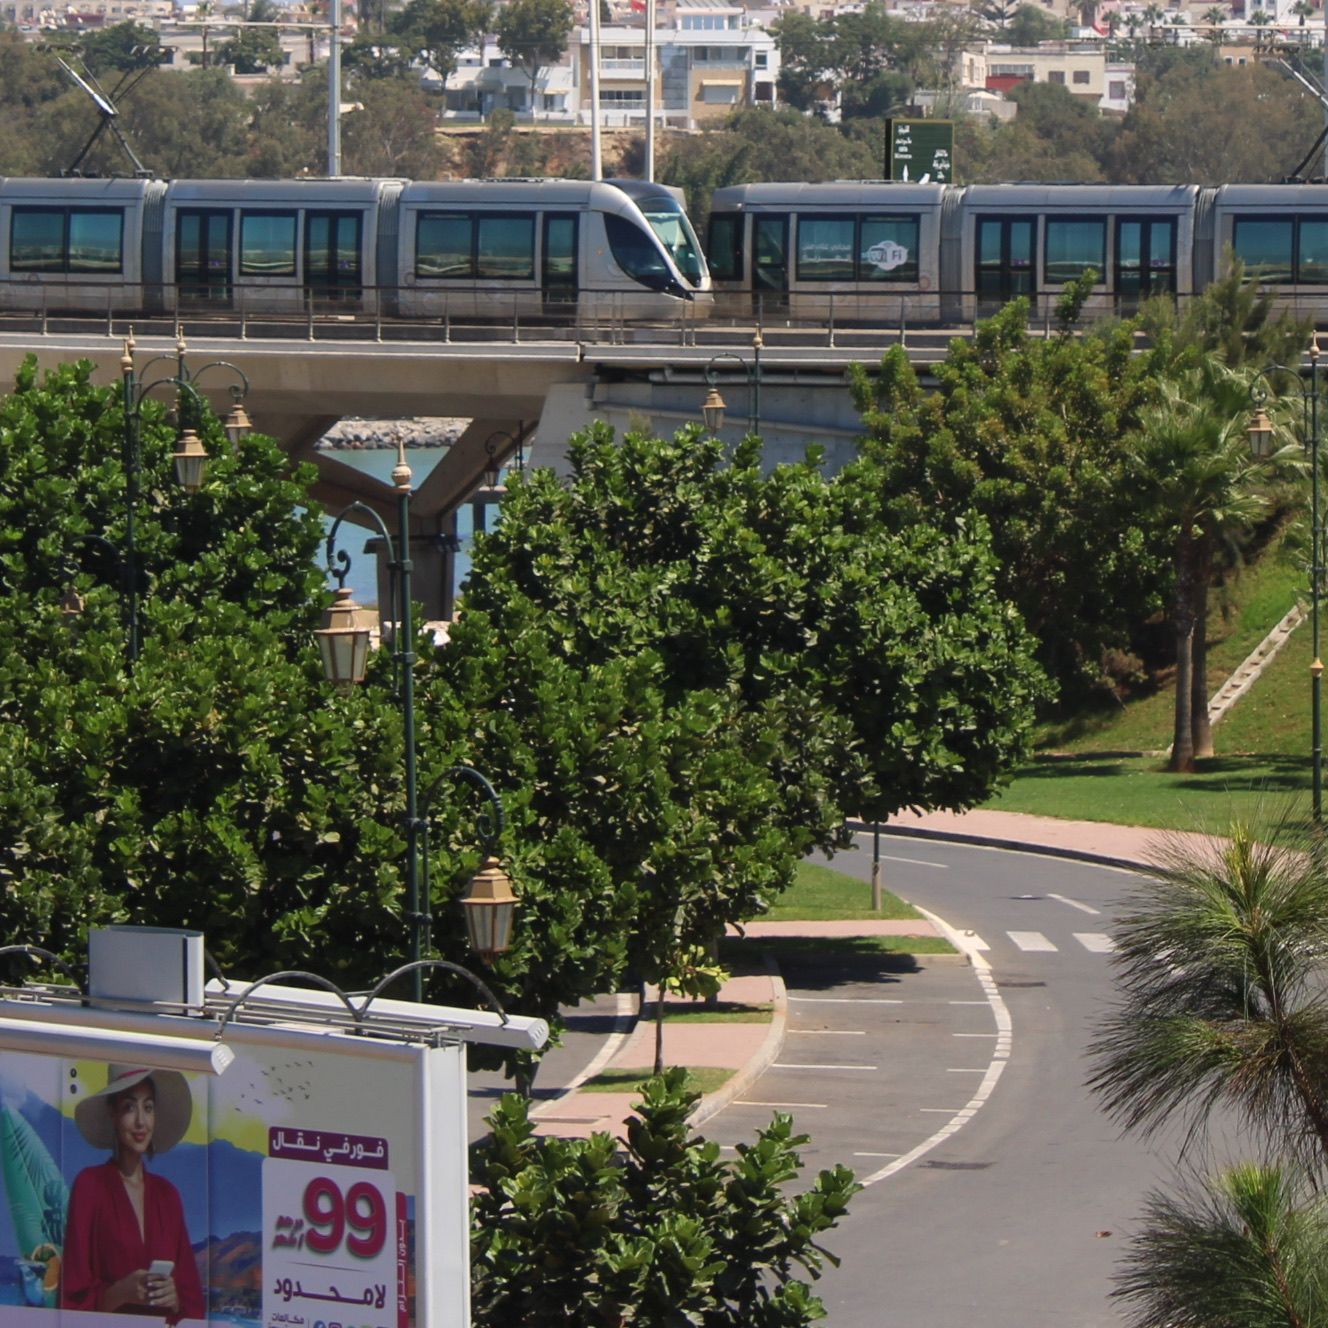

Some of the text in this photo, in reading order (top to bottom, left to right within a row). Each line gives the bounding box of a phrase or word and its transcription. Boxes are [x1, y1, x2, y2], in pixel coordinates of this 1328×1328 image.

[272, 1131, 385, 1162] فورفي نقال
[304, 1177, 387, 1258] 99
